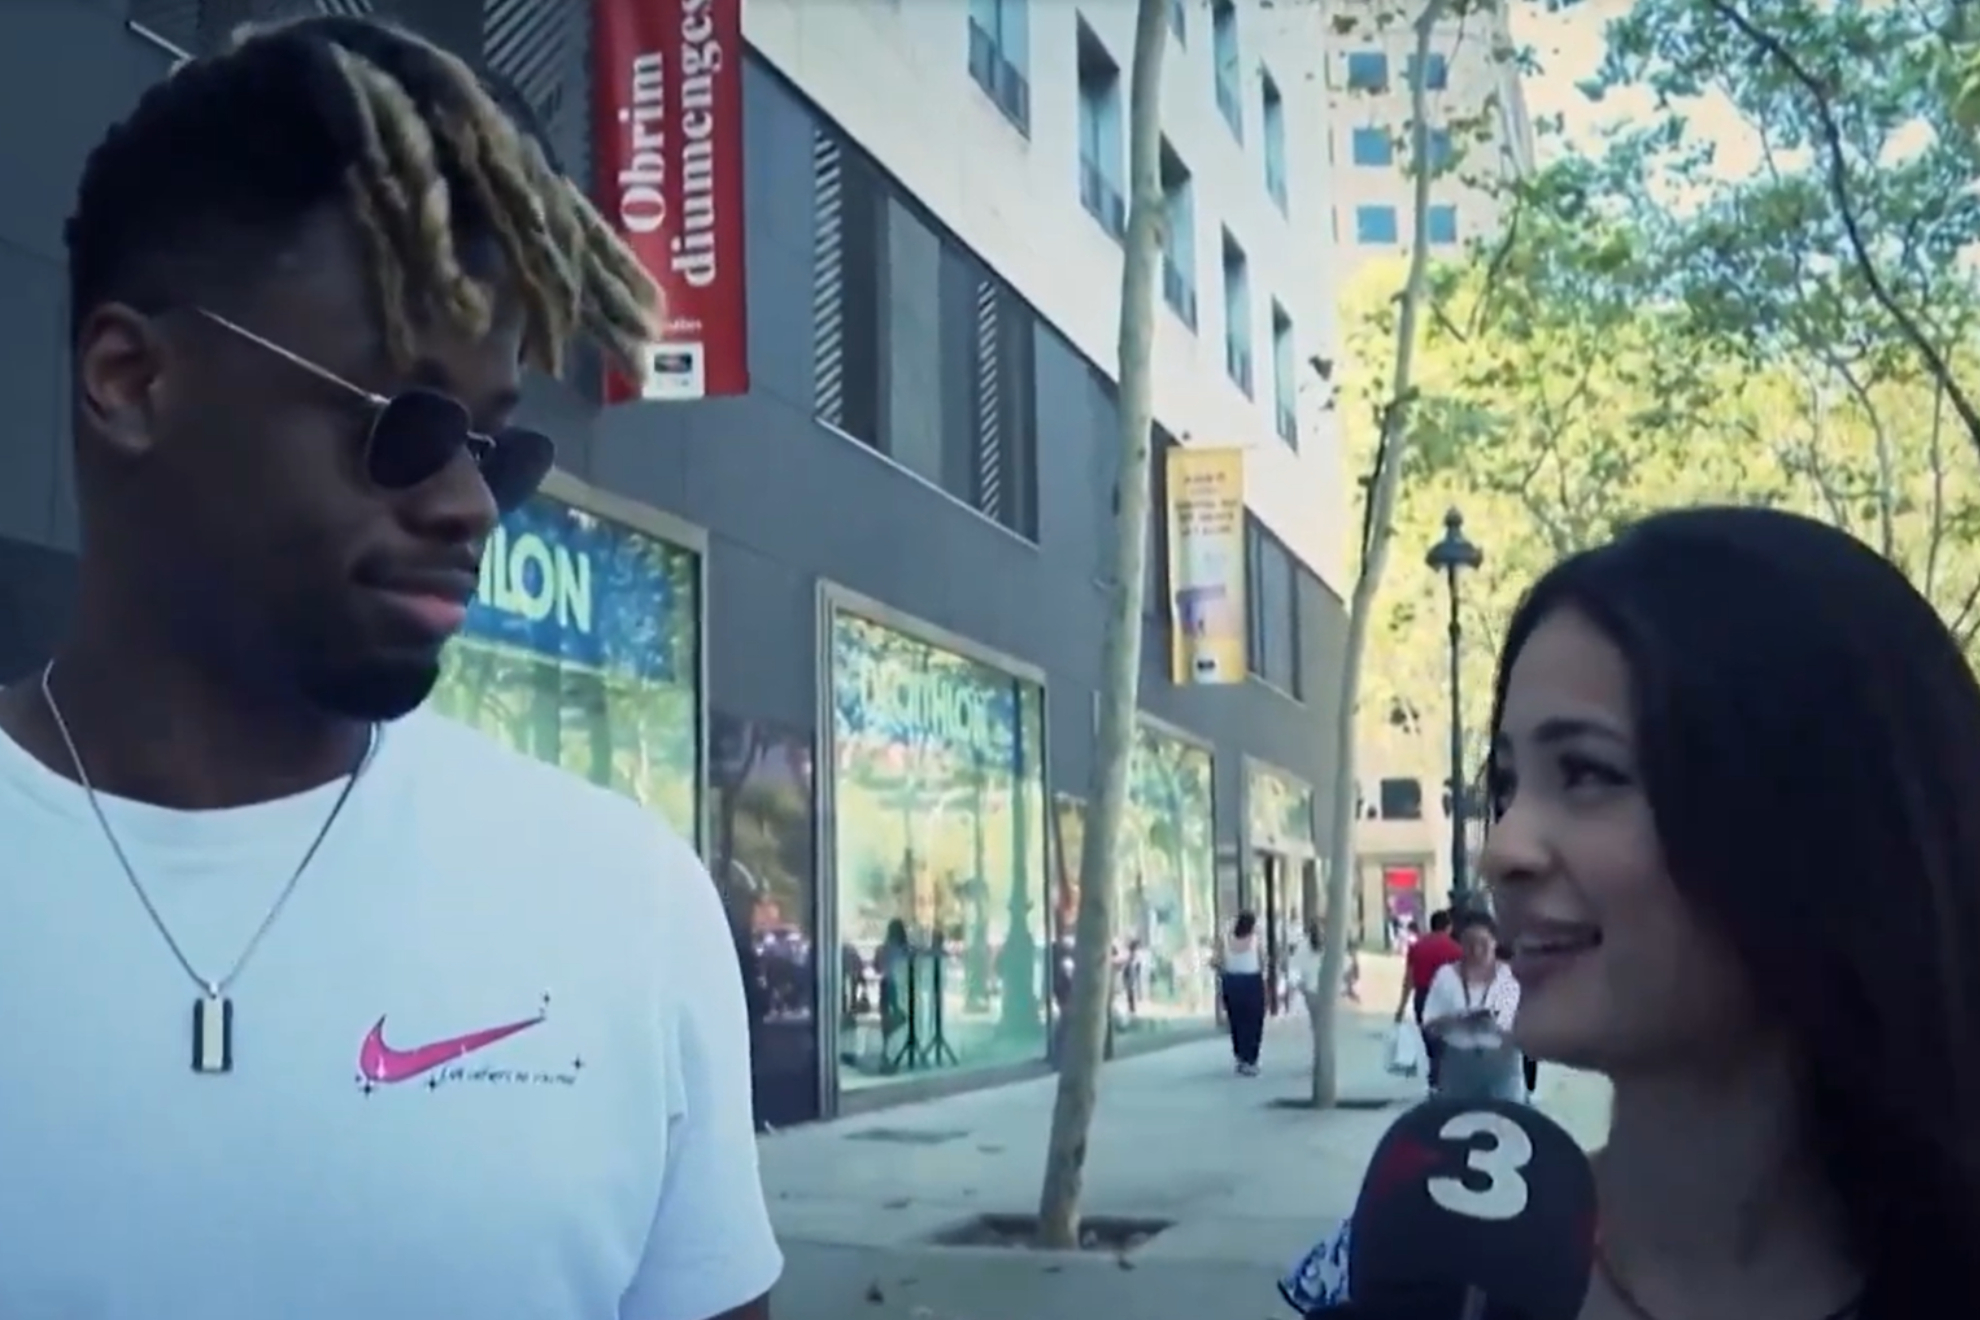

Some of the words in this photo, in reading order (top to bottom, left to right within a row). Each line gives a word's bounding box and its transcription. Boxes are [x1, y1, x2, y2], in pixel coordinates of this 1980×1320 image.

[619, 51, 666, 232] Obrim
[671, 0, 722, 287] diumenges
[1427, 1110, 1533, 1221] 3
